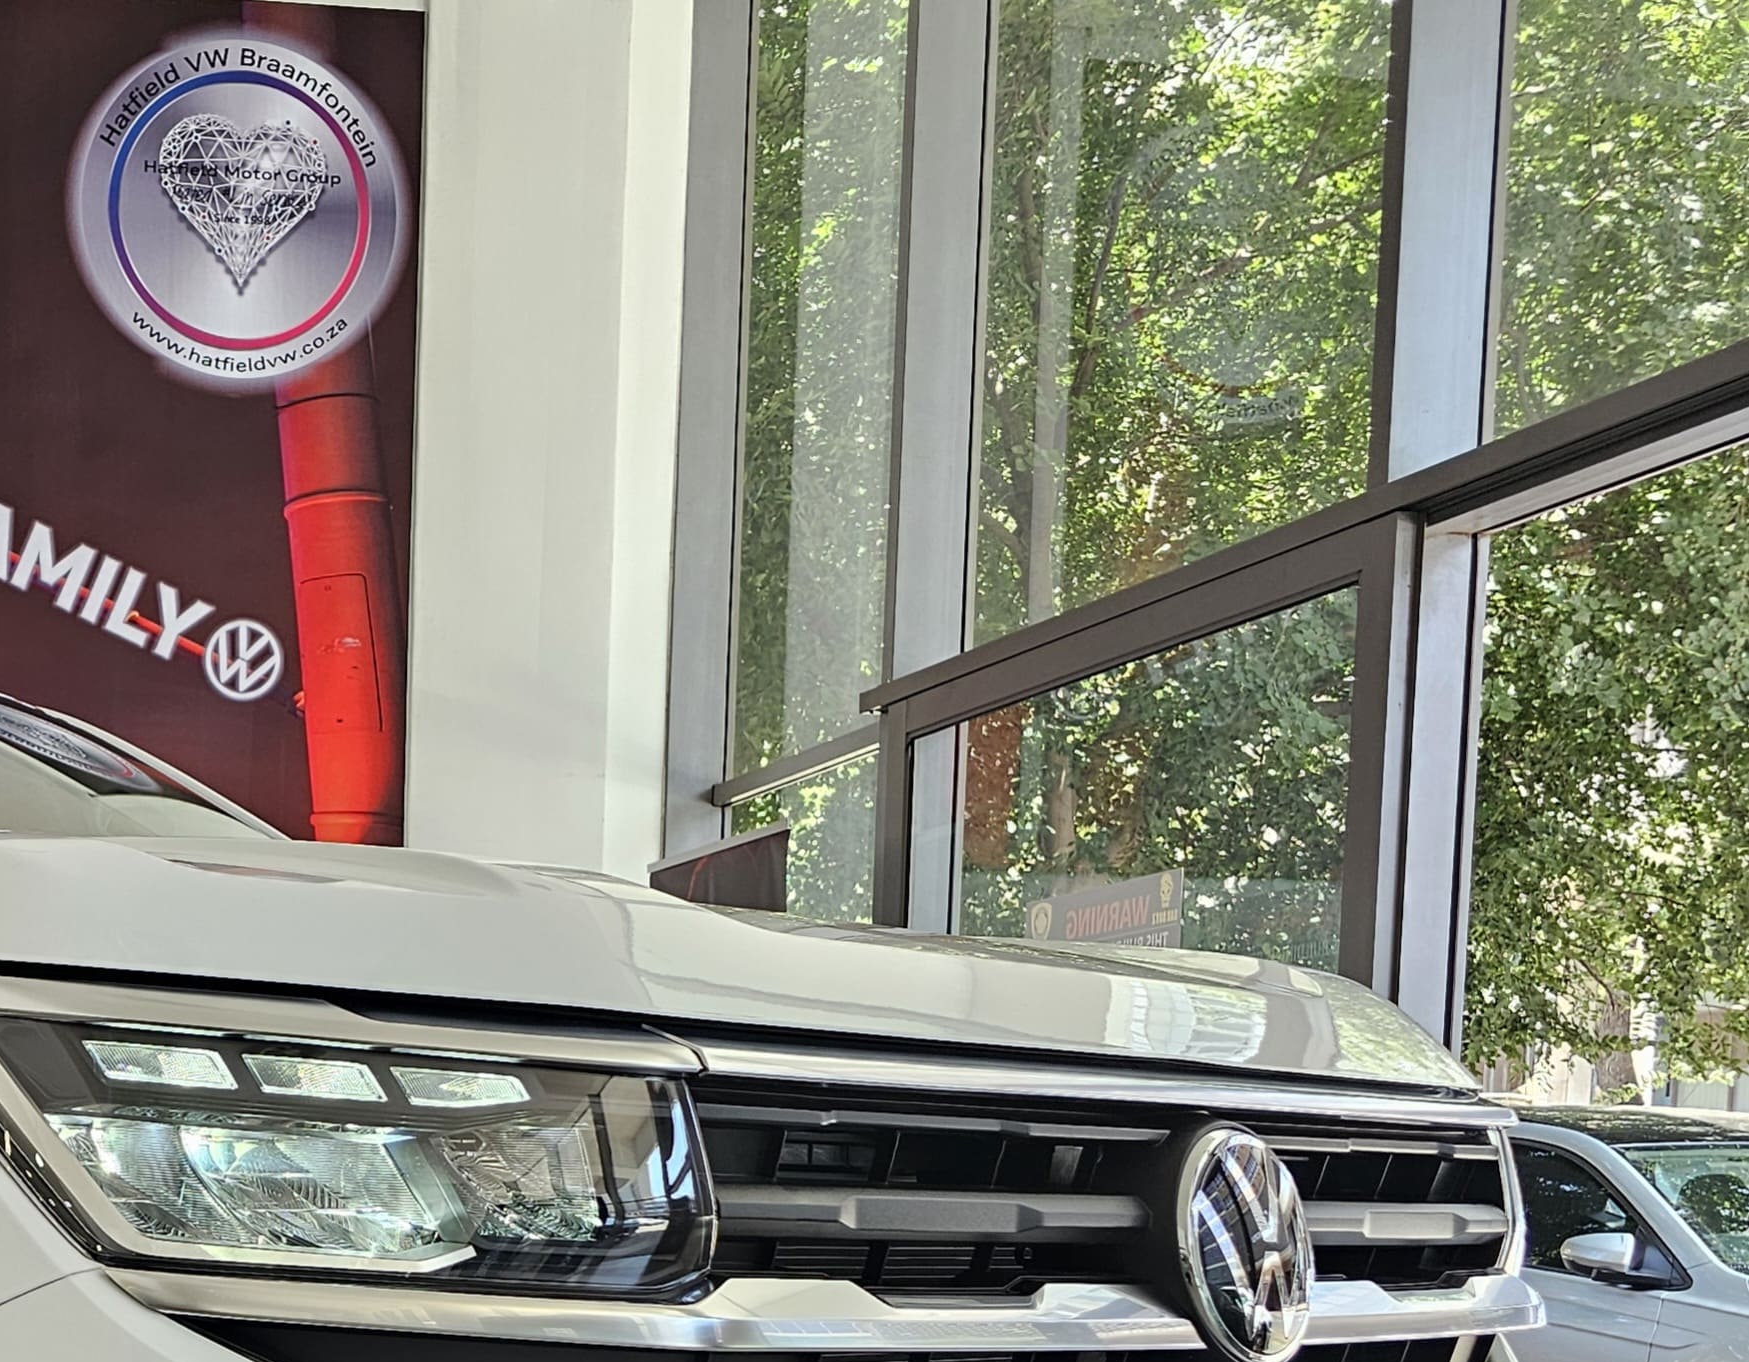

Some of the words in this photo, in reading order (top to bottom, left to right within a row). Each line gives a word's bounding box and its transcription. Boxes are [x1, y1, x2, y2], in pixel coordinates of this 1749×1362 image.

[99, 63, 181, 148] Hatfield
[184, 48, 230, 75] VW
[240, 47, 378, 169] Braamfontein
[144, 160, 218, 177] Hatfield
[224, 167, 281, 181] Motor
[286, 169, 342, 187] Group
[132, 312, 349, 374] www.hatfieldvw.co.za
